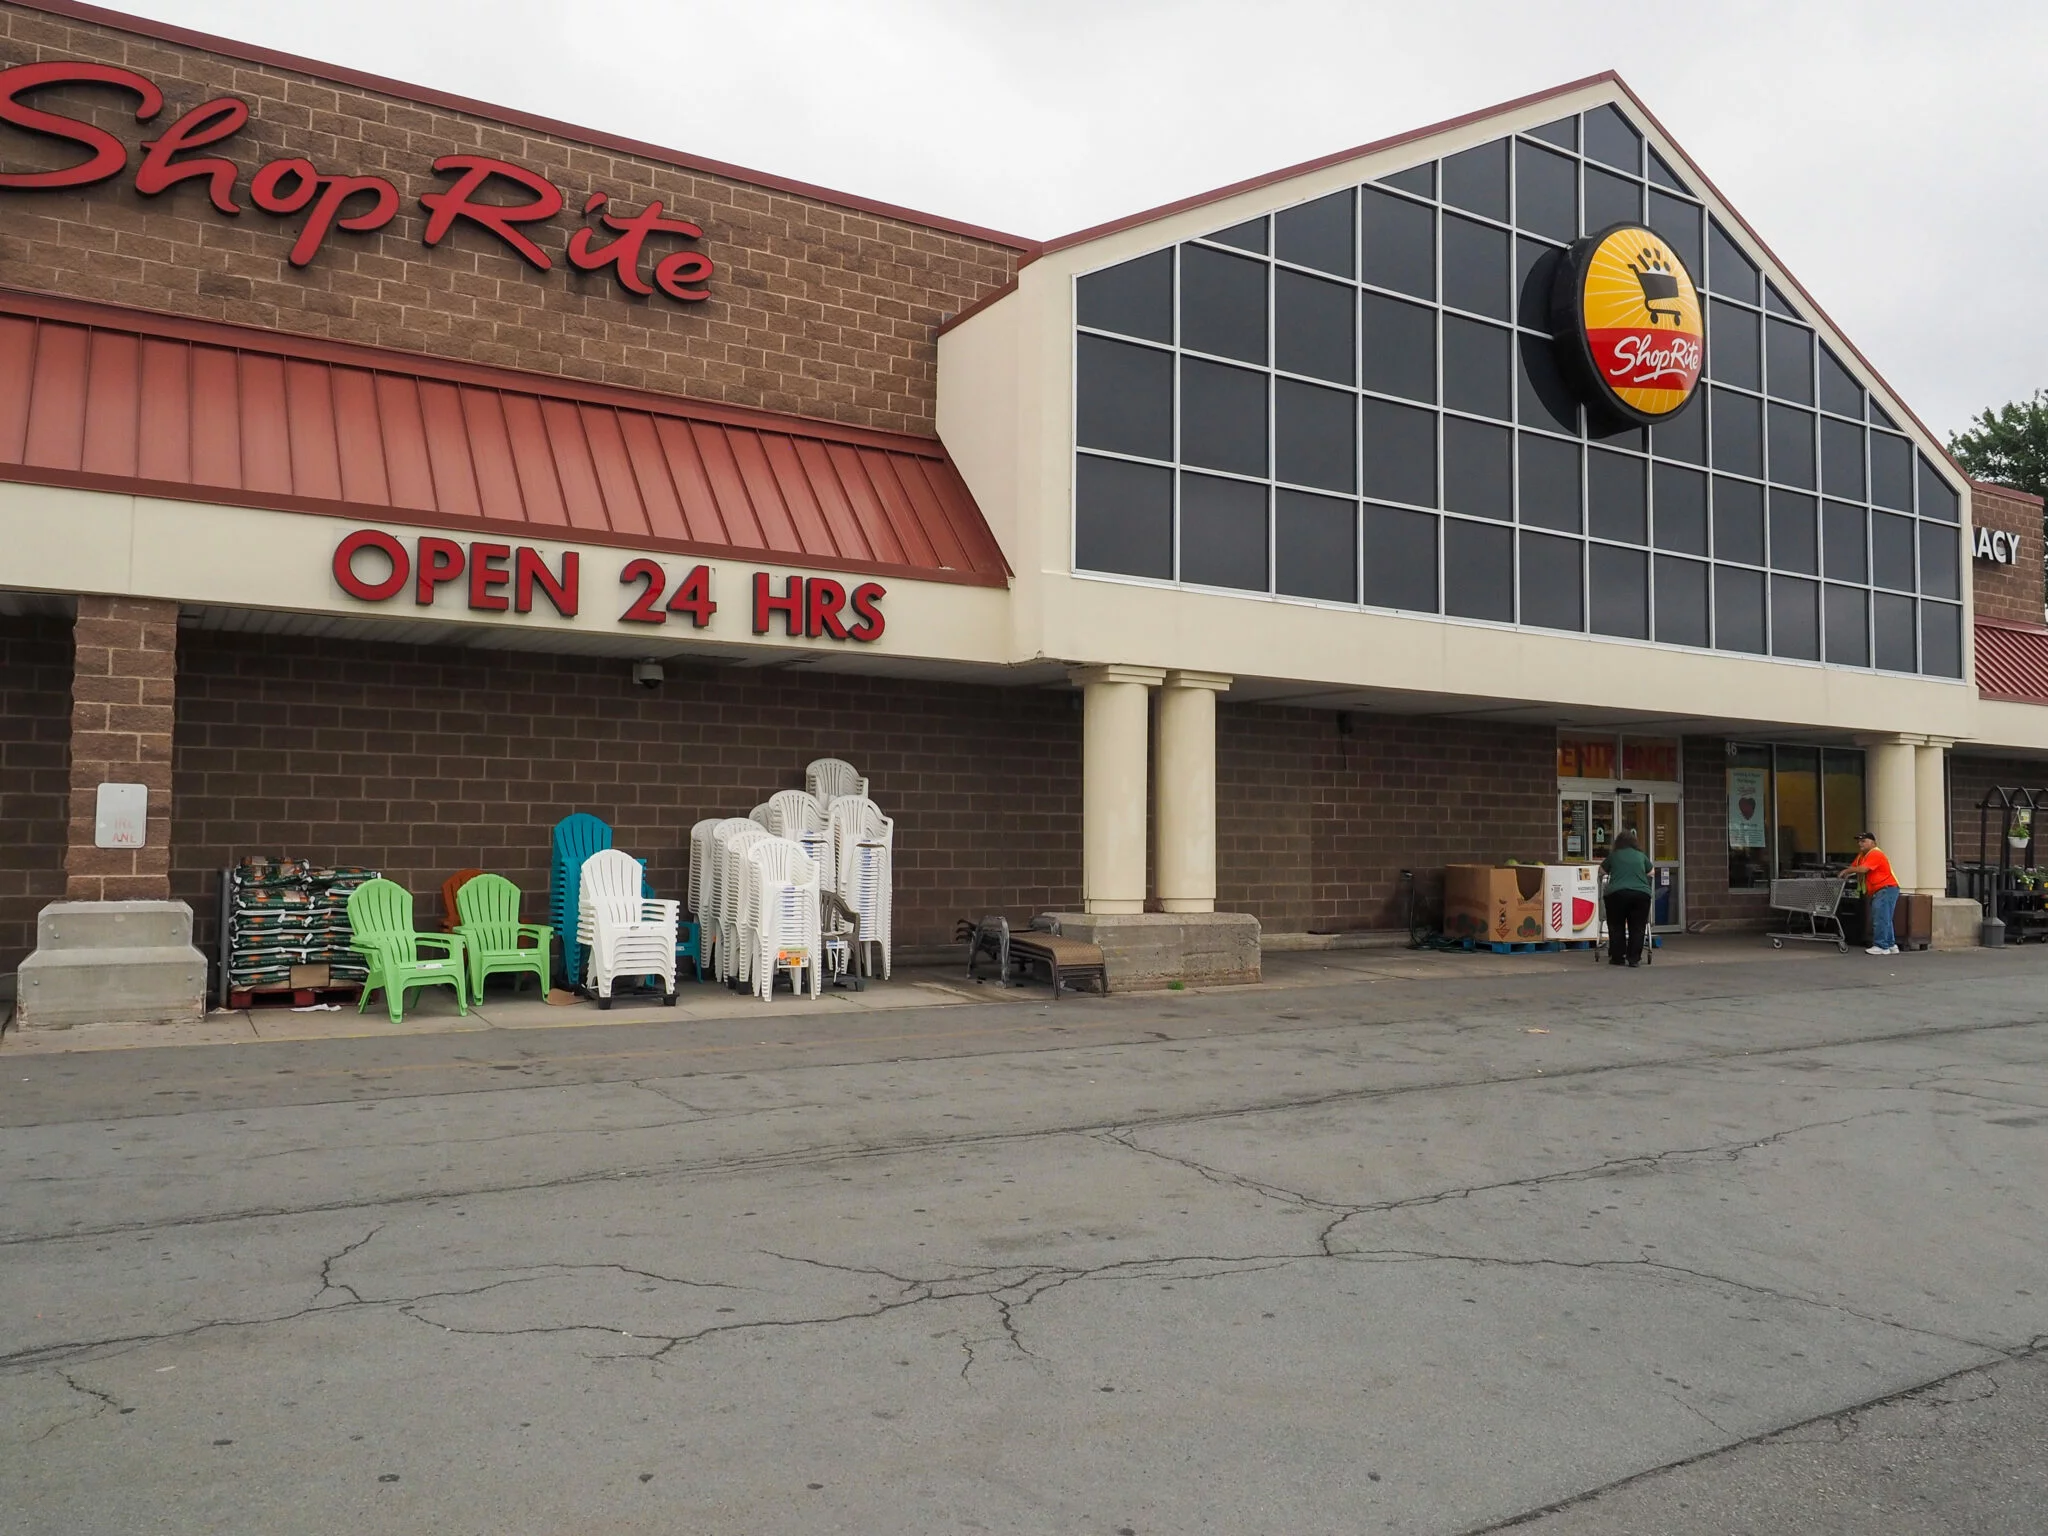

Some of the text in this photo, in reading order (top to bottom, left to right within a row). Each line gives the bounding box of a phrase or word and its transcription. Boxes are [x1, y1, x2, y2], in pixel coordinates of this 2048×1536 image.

[1972, 526, 2020, 565] ACY
[332, 529, 887, 643] OPEN 24 HRS
